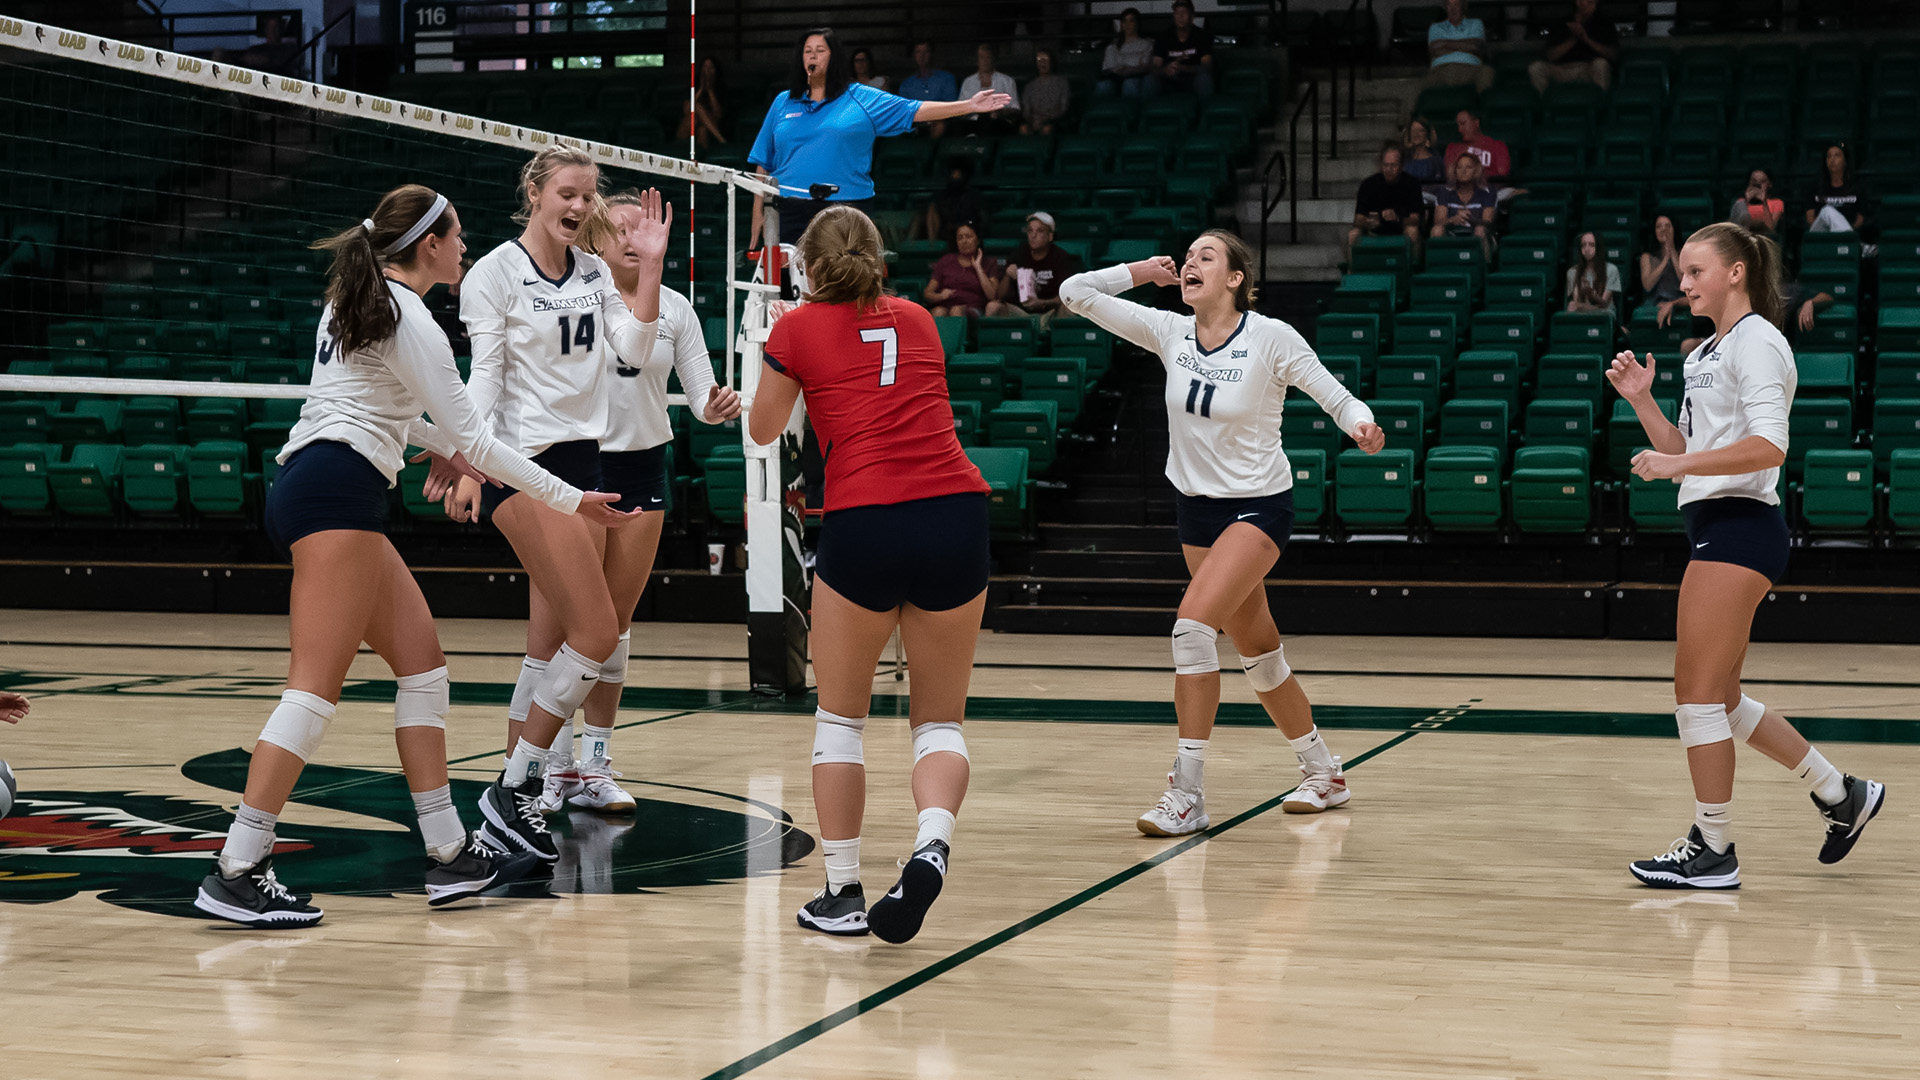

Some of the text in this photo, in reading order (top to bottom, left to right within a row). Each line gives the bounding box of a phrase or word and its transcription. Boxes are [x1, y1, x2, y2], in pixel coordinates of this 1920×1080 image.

[416, 7, 446, 25] 116
[58, 31, 87, 50] UAB
[117, 44, 145, 62] UAB
[176, 56, 202, 74] UAB
[228, 67, 253, 85] UAB
[280, 78, 303, 94] UAB
[326, 88, 347, 104] UAB
[371, 98, 393, 114] UAB
[414, 107, 433, 122] UAB
[455, 115, 474, 130] UAB
[493, 124, 511, 138] UAB
[530, 131, 548, 144] UAB
[598, 145, 613, 157] UAB
[558, 313, 595, 355] 14
[858, 326, 898, 388] 7
[1186, 379, 1216, 419] 11
